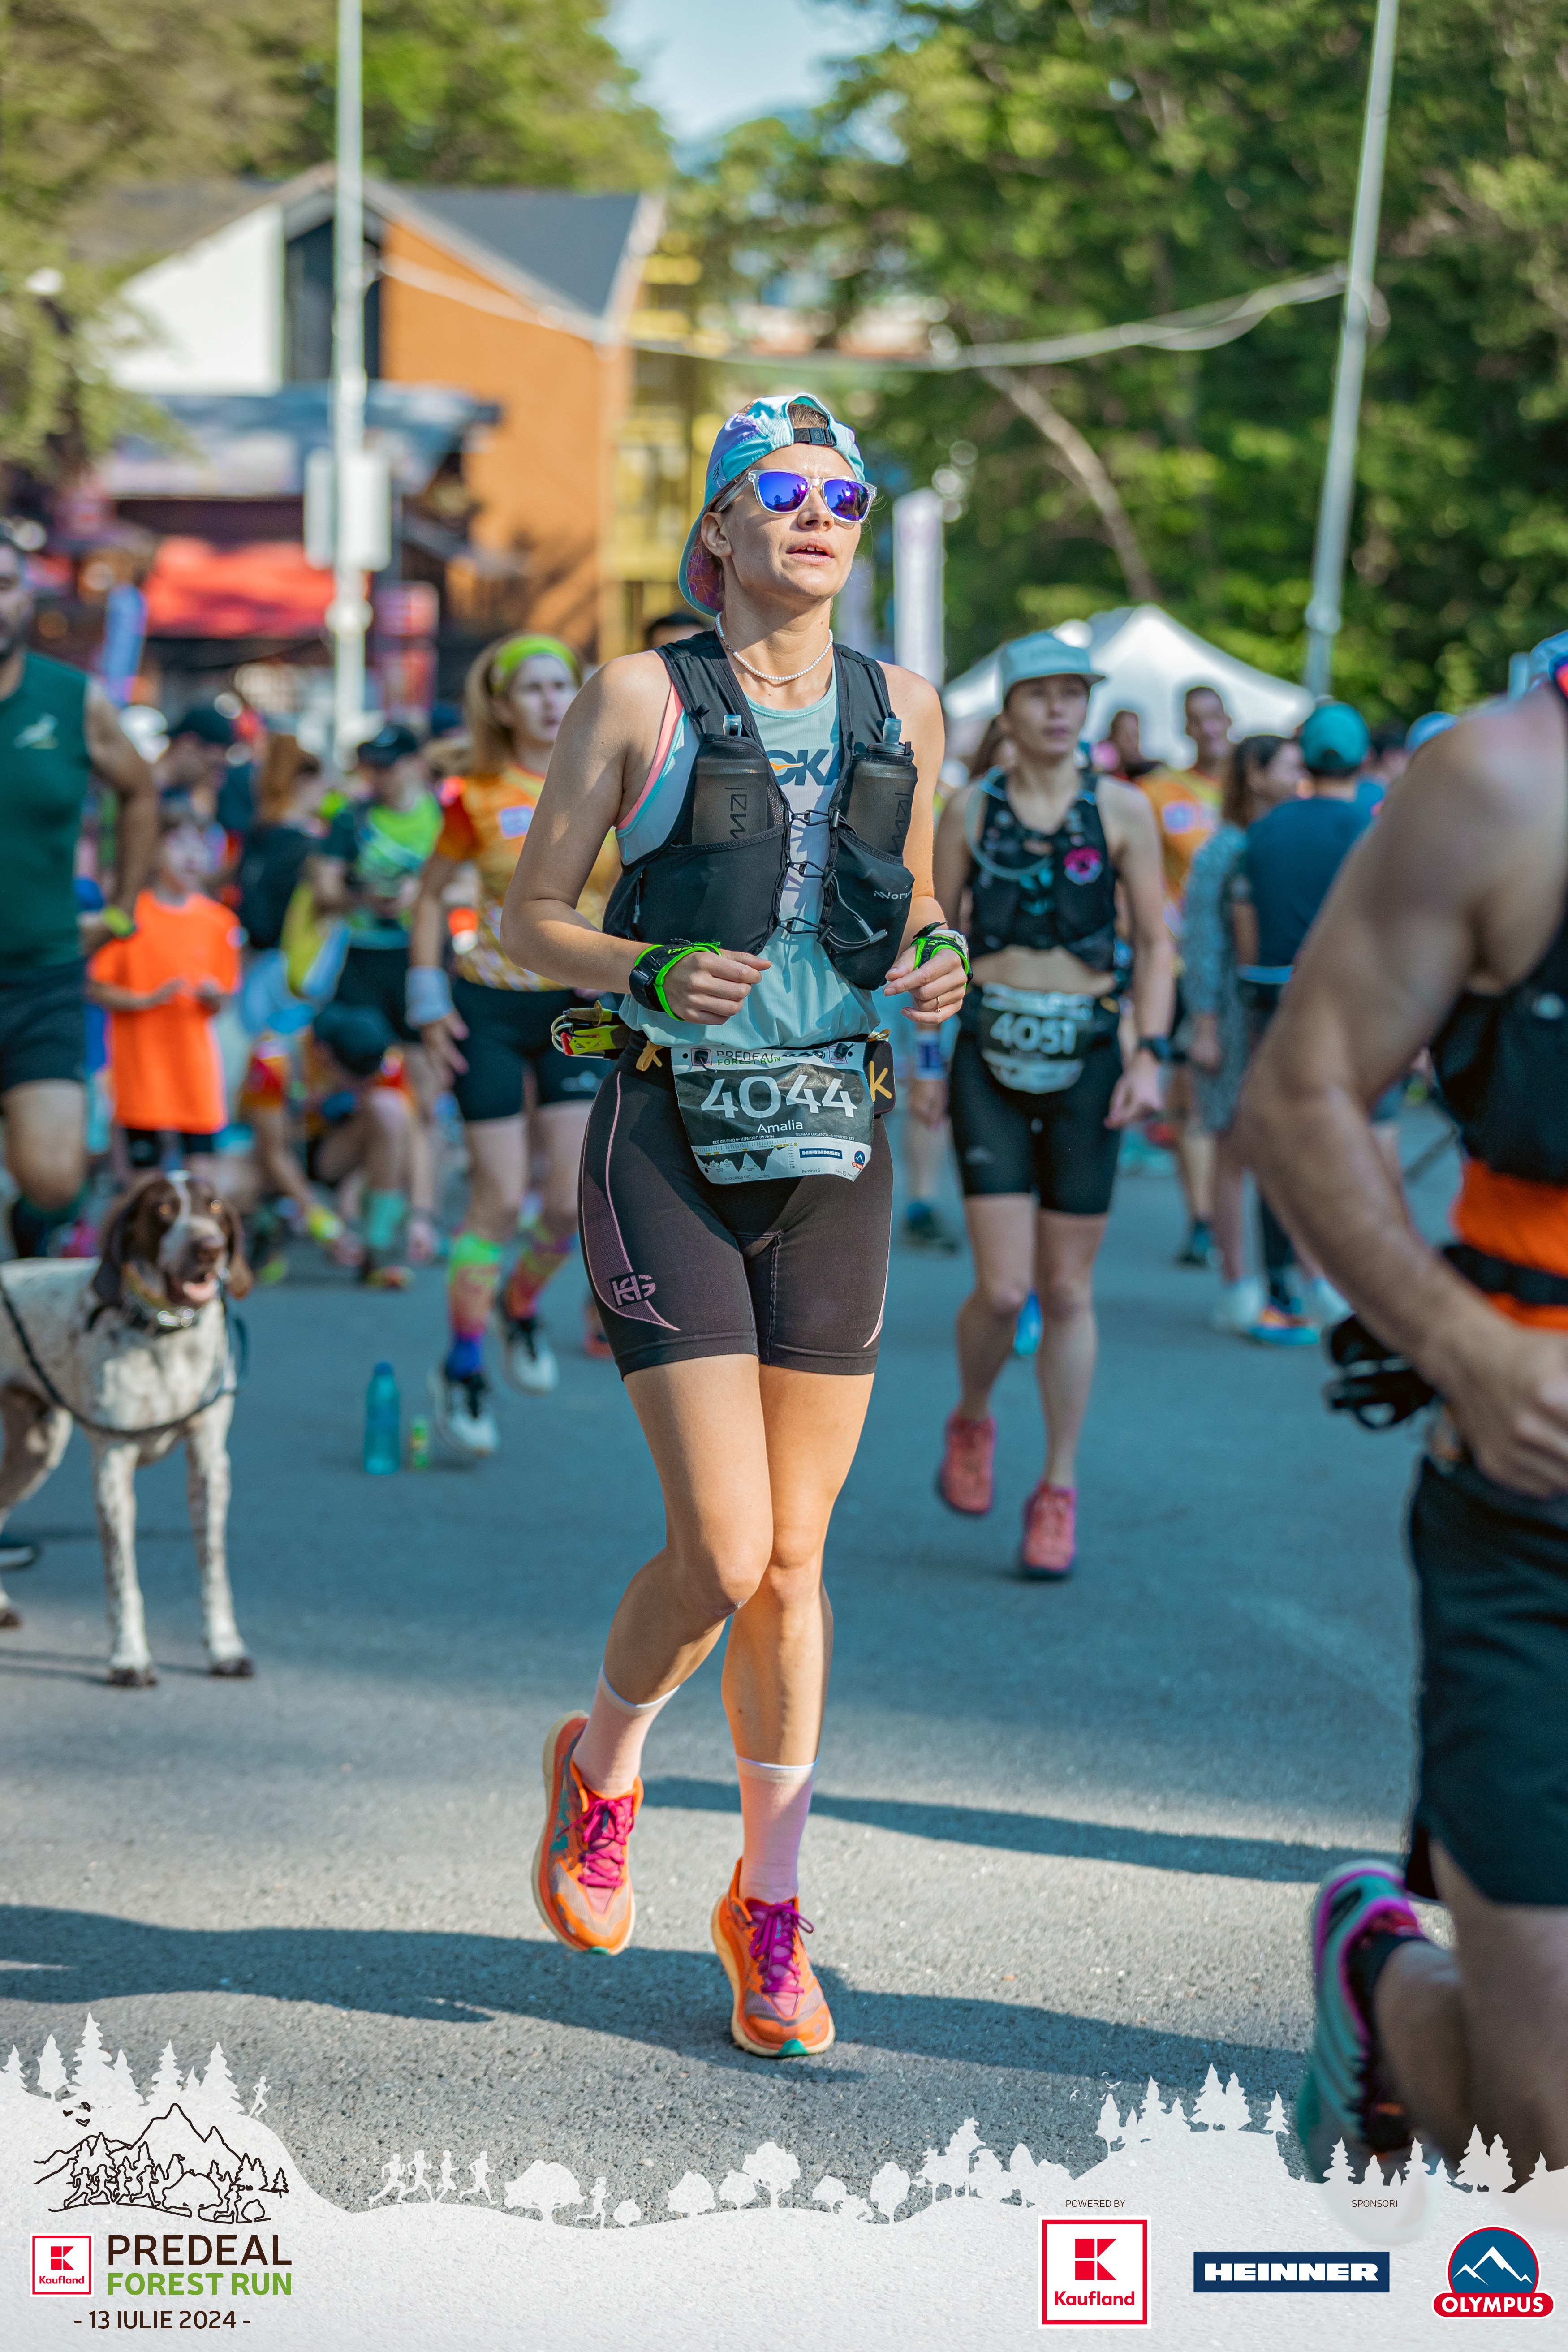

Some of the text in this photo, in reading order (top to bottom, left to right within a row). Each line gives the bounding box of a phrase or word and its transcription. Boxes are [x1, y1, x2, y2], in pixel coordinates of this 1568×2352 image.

[990, 1012, 1076, 1054] 4051
[700, 1074, 857, 1119] 4044
[757, 1120, 803, 1133] Amalia
